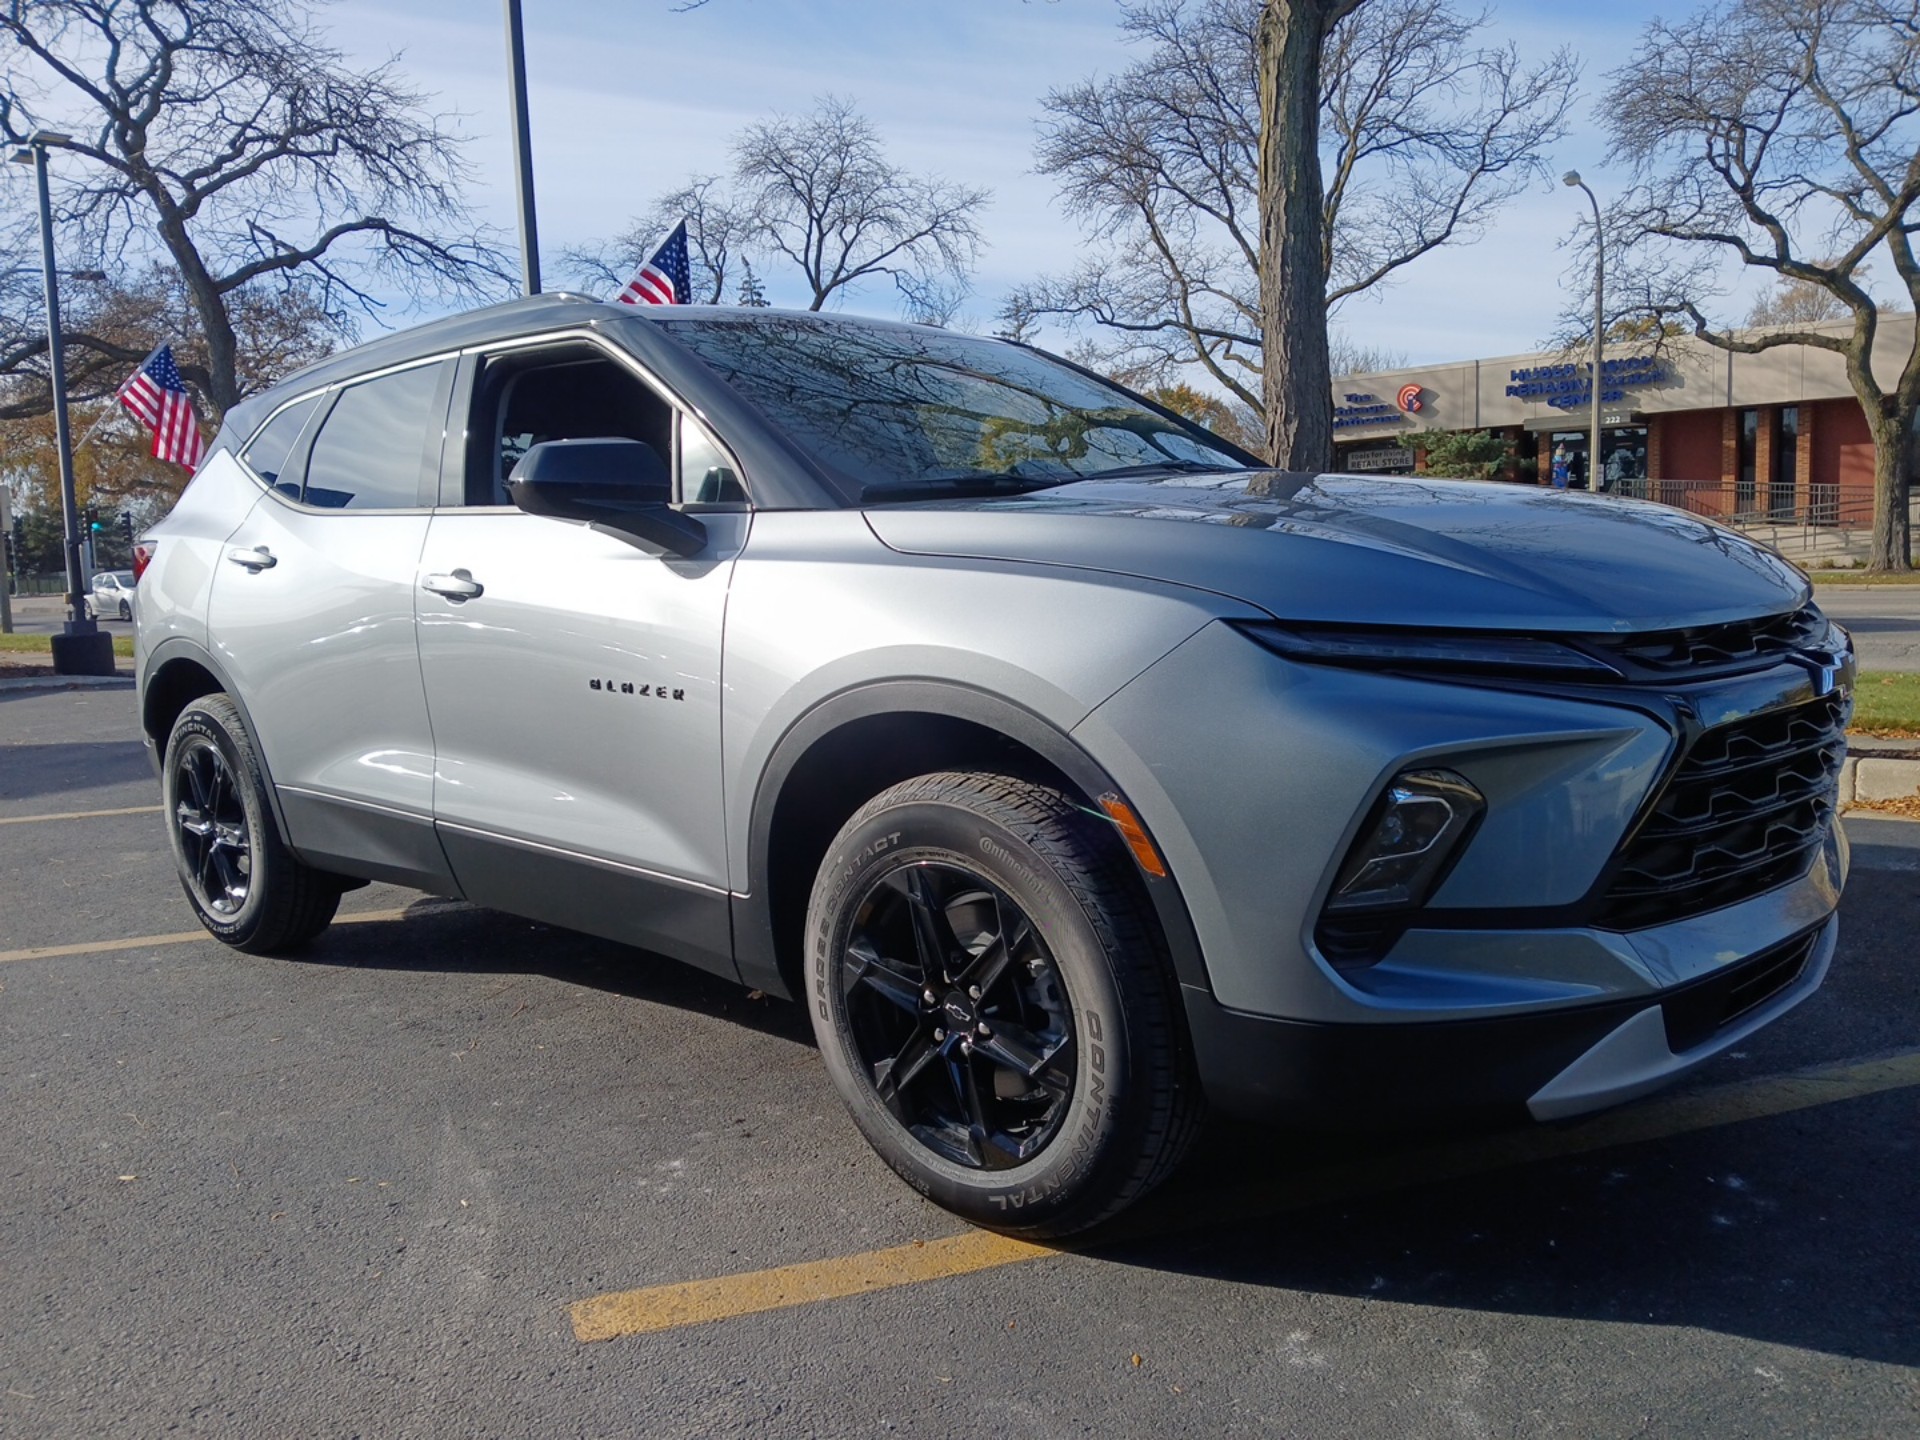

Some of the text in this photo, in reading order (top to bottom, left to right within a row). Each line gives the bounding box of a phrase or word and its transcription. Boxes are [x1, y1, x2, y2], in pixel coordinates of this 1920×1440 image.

[1510, 363, 1577, 382] HUBER
[1605, 415, 1621, 424] 222
[1351, 457, 1410, 468] RETAIL STORE
[589, 679, 685, 701] BLAZER
[988, 1009, 1105, 1211] CONTINENTAL
